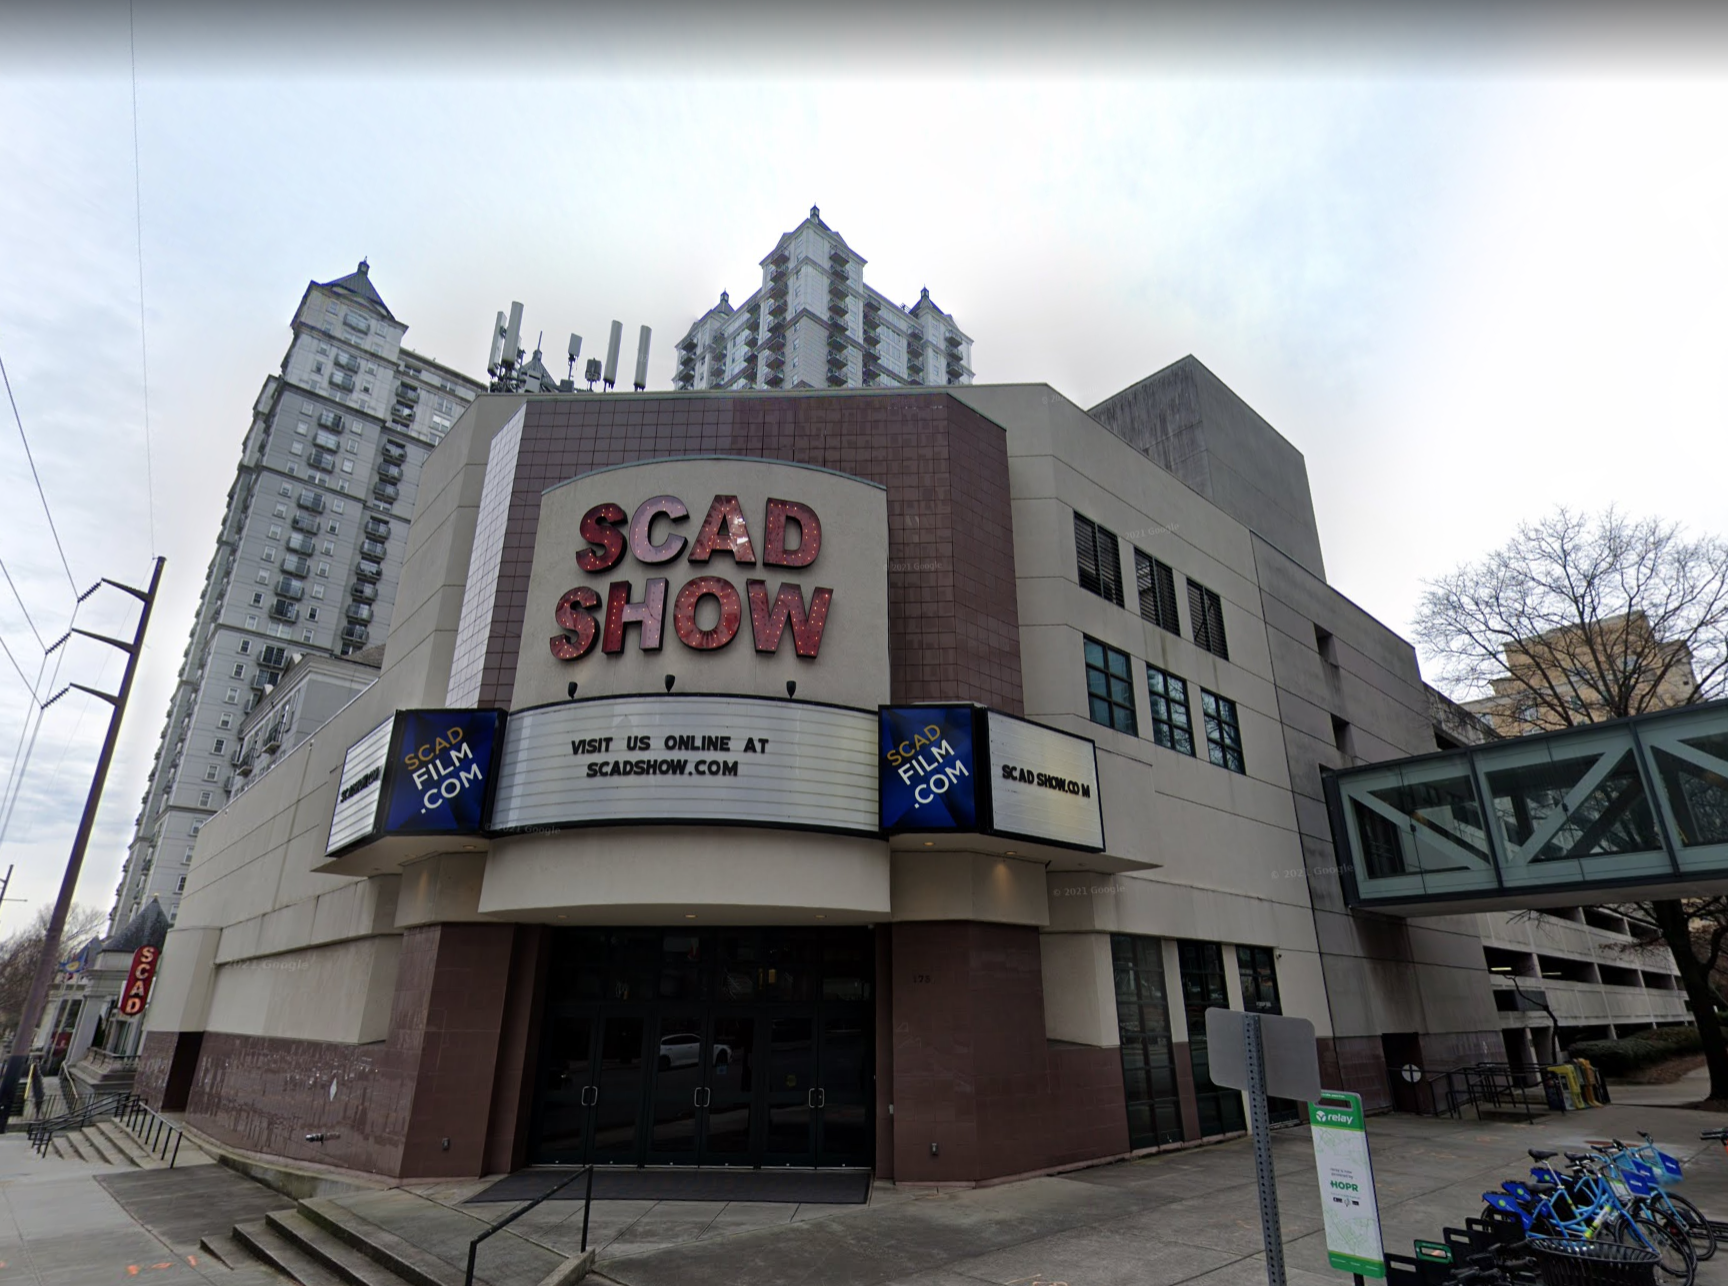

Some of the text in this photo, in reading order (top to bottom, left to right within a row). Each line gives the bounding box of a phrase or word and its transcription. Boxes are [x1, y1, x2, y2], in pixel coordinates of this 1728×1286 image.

[575, 494, 822, 574] SCAD
[549, 574, 834, 661] SHOW
[404, 726, 464, 770] SCAD
[412, 741, 473, 790] FILM
[571, 735, 769, 755] VISIT US ONLINE AT
[586, 759, 739, 778] SCADSHOW.COM
[886, 724, 941, 766] SCAD
[897, 738, 955, 786] FILM
[421, 762, 483, 814] .COM
[913, 759, 970, 809] .COM
[124, 946, 155, 1014] SCAD
[1327, 1113, 1353, 1125] relay
[1330, 1180, 1359, 1193] HOPR
